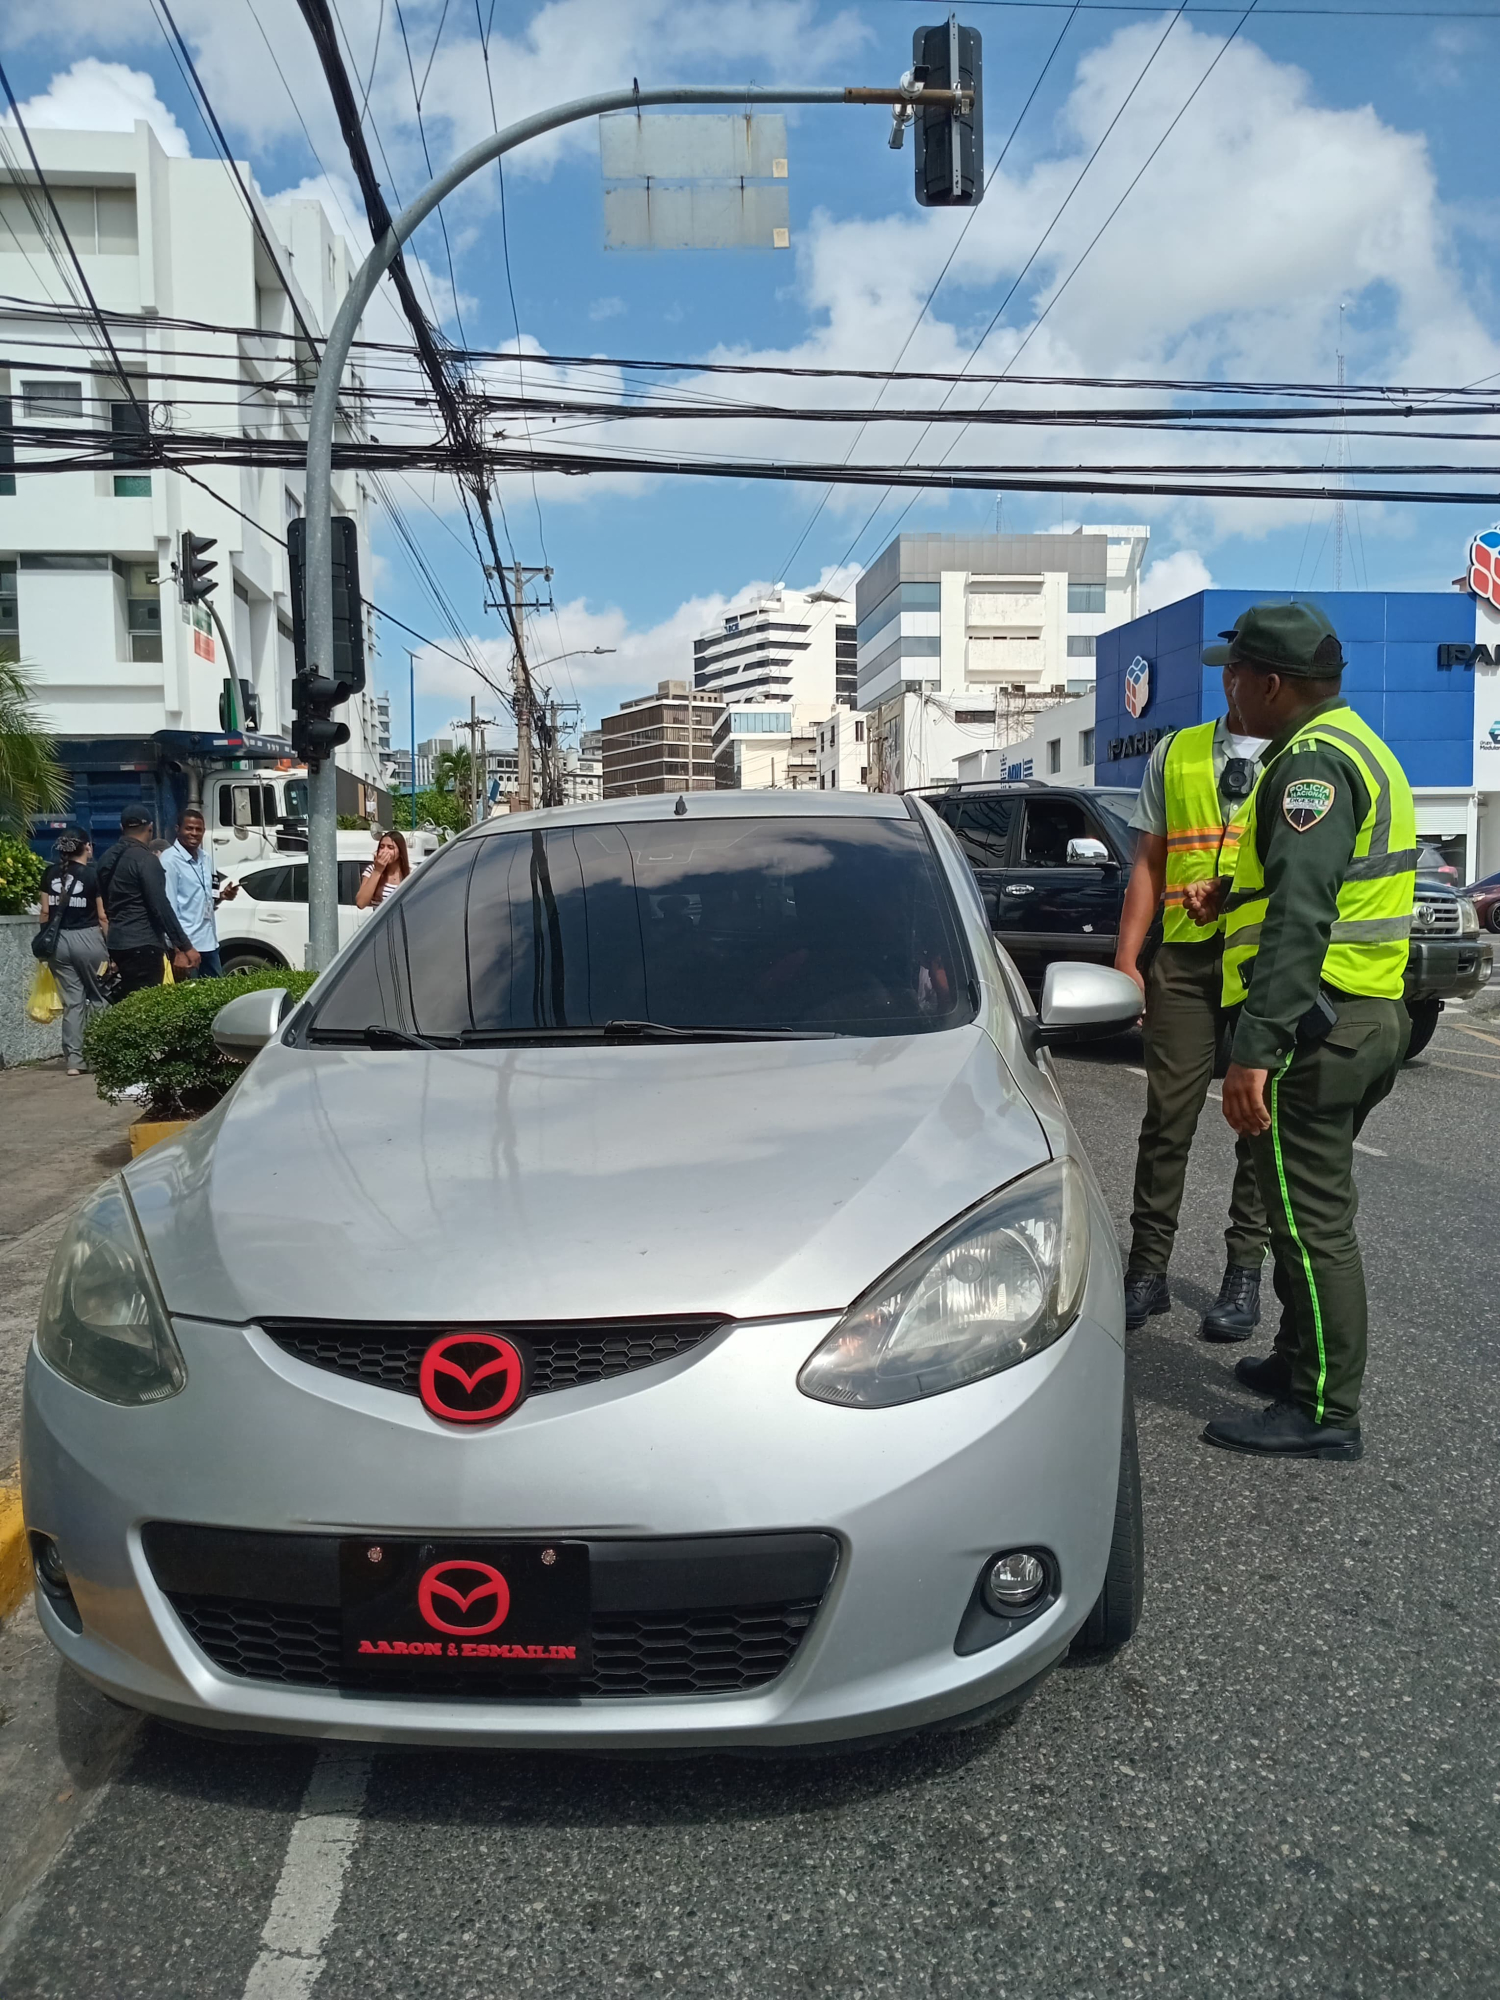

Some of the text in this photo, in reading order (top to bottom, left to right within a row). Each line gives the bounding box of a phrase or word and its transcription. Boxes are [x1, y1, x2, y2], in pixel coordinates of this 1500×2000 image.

[1289, 783, 1330, 796] POLICIA
[1290, 790, 1326, 800] NACIONAL
[358, 1640, 576, 1659] AARON & ESMAILIN
